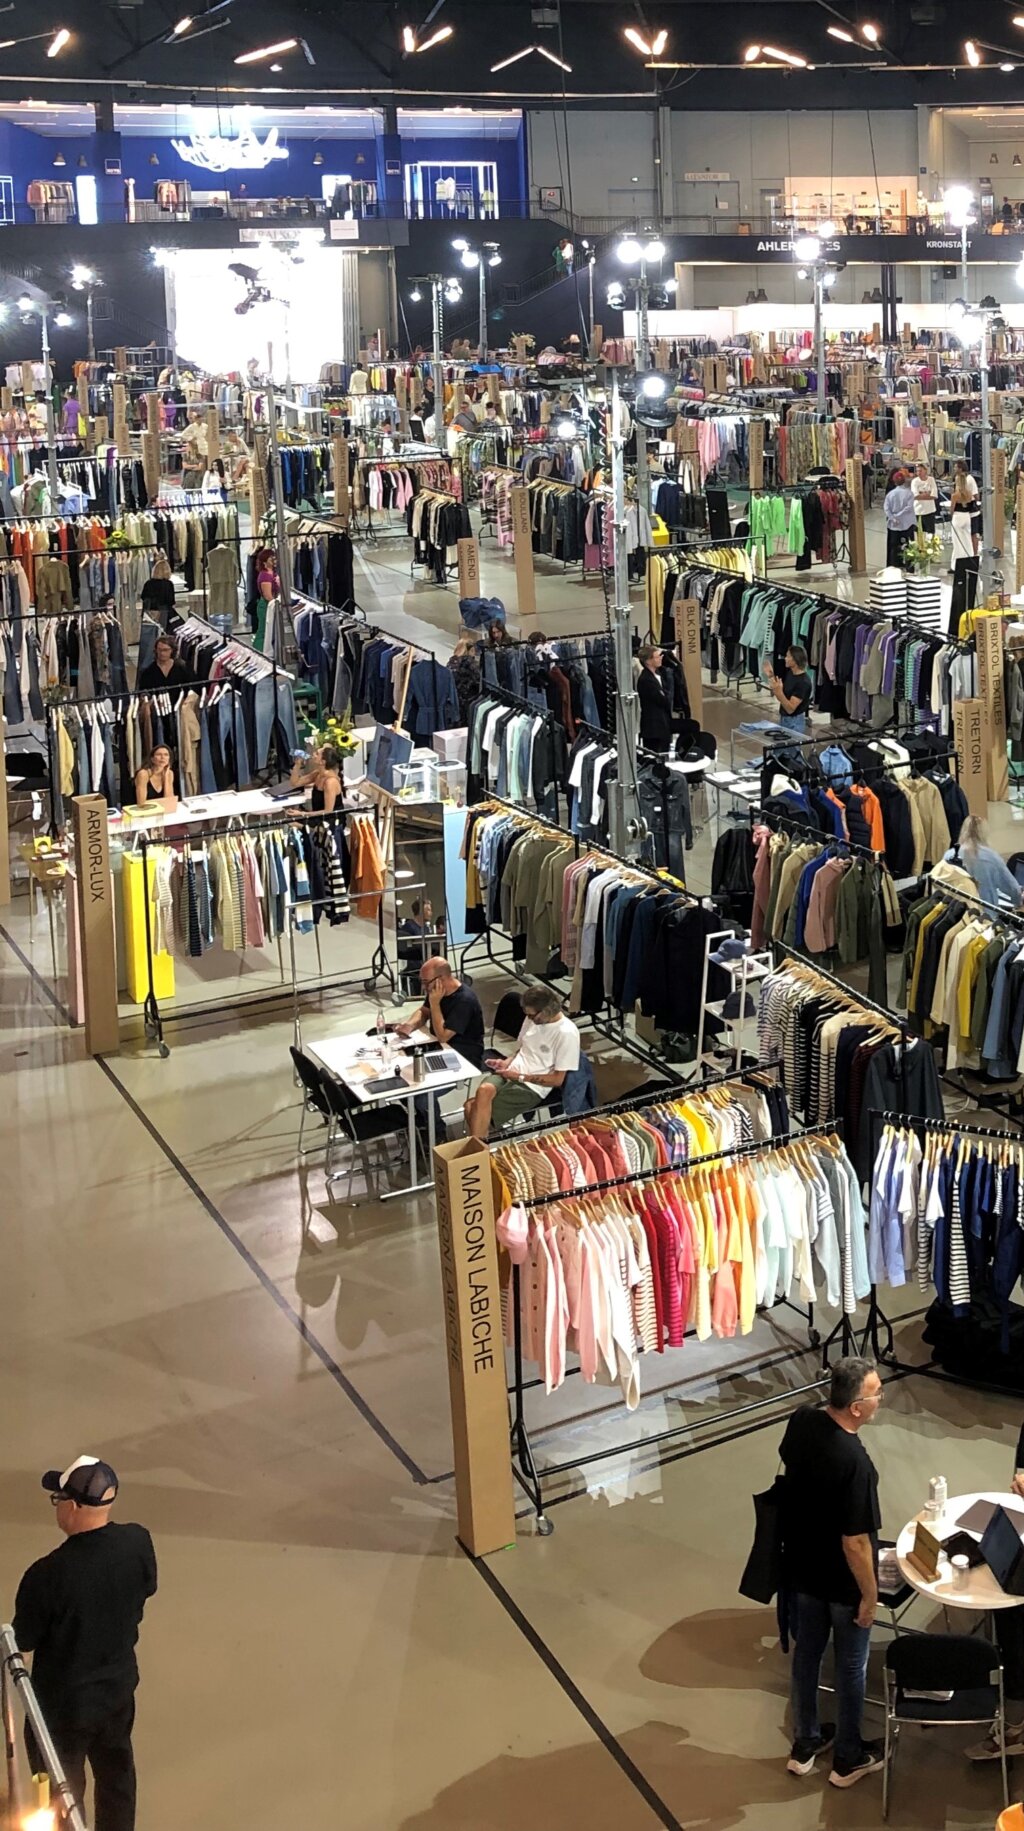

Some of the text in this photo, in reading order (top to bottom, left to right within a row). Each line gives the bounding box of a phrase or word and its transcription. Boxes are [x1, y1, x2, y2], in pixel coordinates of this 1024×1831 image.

[519, 492, 528, 534] SOULLAND
[467, 544, 476, 581] AMENDI
[686, 606, 697, 654] BLK DNM
[978, 622, 986, 670] BRIXTOL
[990, 622, 1003, 726] BRIXTOL TEXTILES
[956, 710, 964, 775] TRETORN
[970, 708, 982, 775] TRETORN
[86, 809, 105, 903] ARMOR-LUX
[436, 1165, 460, 1373] MAISON LABICHE
[461, 1164, 494, 1375] MAISON LABICHE
